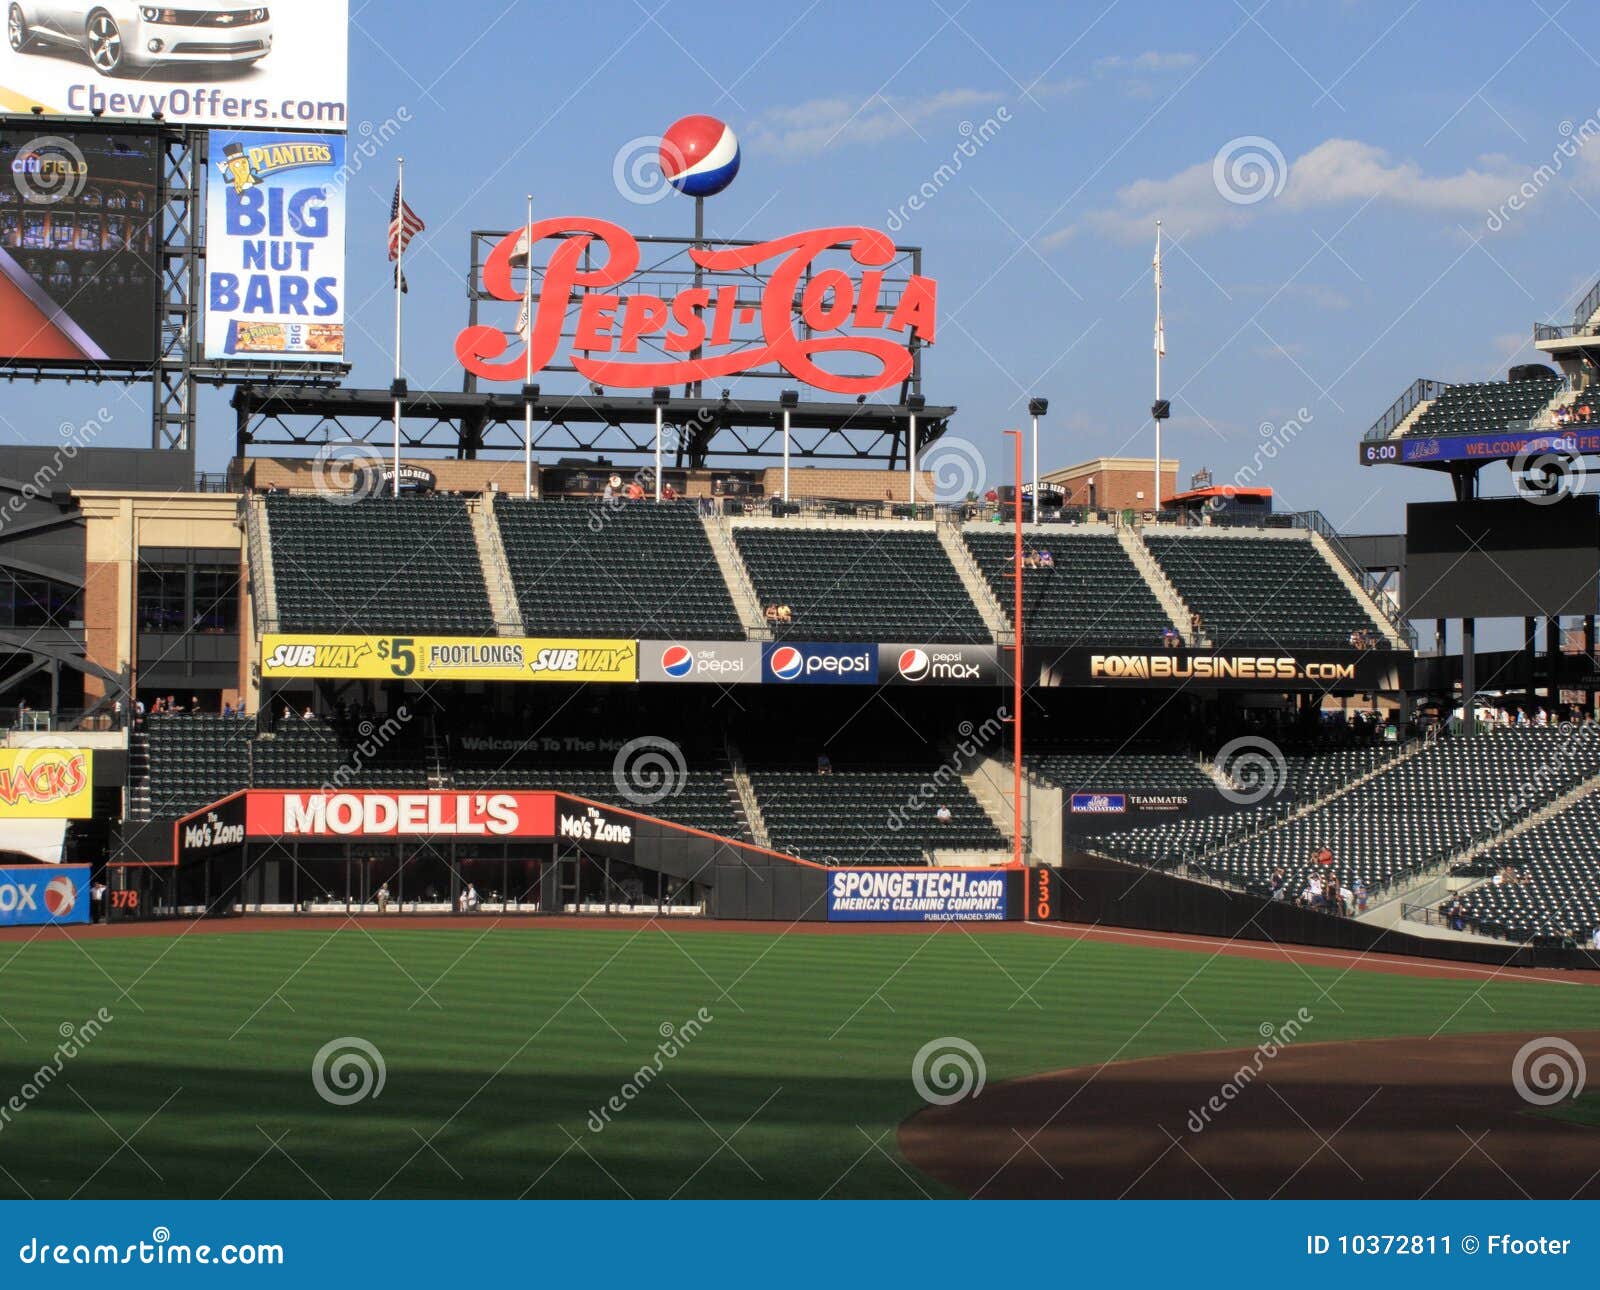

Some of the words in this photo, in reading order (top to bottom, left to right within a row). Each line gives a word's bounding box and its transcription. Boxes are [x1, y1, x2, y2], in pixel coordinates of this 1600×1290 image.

[66, 84, 345, 122] ChevyOffers.com
[43, 160, 87, 174] FIELD
[248, 145, 332, 171] PLANTERS
[225, 186, 329, 238] BIG
[243, 240, 315, 271] NUT
[210, 272, 338, 316] BARS
[1367, 446, 1396, 460] 6:00
[1466, 440, 1528, 455] WELCOME
[382, 470, 412, 480] BOTLED
[1021, 482, 1049, 493] BOTLED
[265, 643, 372, 670] SUBWAY
[377, 638, 415, 676] $5
[431, 645, 523, 663] FOOTLONGS
[529, 645, 633, 674] SUBWAY
[932, 652, 962, 664] pepsi
[697, 657, 744, 674] pepsi
[806, 653, 870, 675] pepsi
[932, 663, 980, 679] max
[461, 736, 537, 751] Welcome
[563, 737, 596, 751] The
[1131, 796, 1188, 804] TEAMMATES
[284, 793, 519, 835] MODELL'S
[587, 807, 600, 818] The
[185, 823, 212, 848] Mo's
[212, 821, 244, 845] Zone
[561, 813, 592, 839] Mo's
[594, 818, 632, 844] Zone
[832, 872, 1003, 898] SPONGETECH.com
[112, 890, 138, 908] 378
[832, 897, 890, 911] AMERICA'S
[892, 897, 945, 911] CLEANING
[924, 913, 955, 921] PUBLICLY
[984, 913, 1003, 921] SPNG
